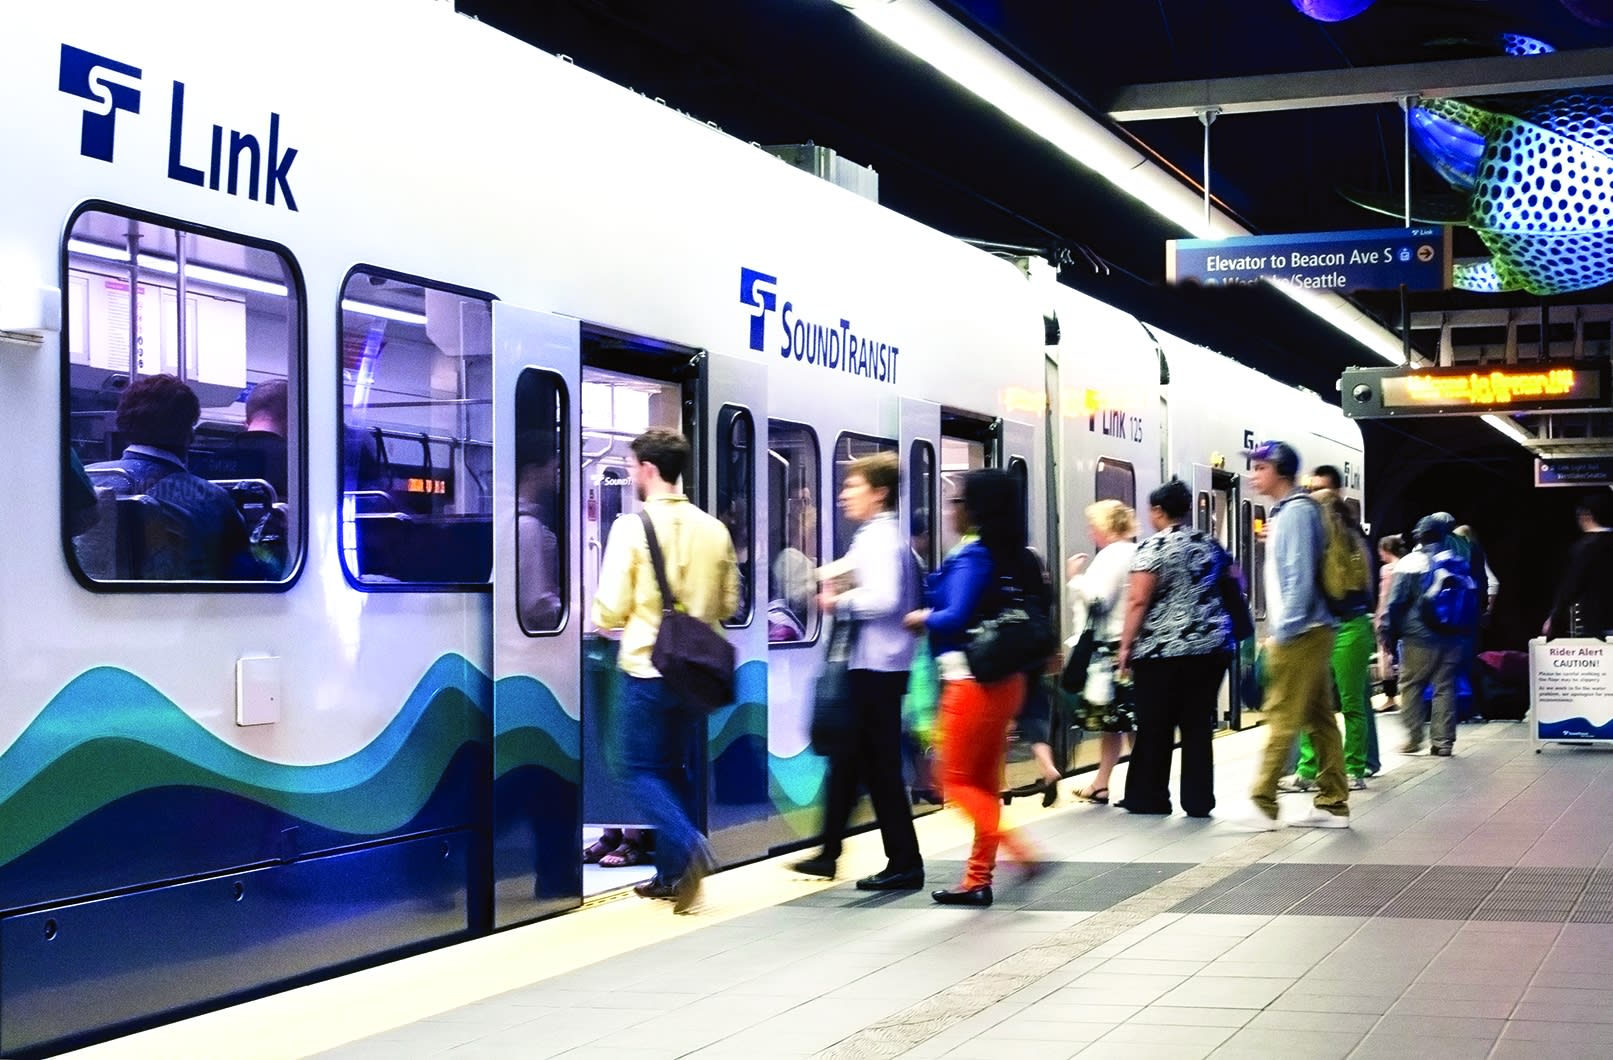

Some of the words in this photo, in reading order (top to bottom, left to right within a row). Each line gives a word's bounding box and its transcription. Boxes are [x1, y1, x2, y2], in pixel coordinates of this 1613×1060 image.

[168, 80, 299, 213] Link
[1207, 253, 1266, 272] Elevator
[1271, 254, 1286, 269] to
[1291, 249, 1344, 268] Beacon
[1349, 249, 1379, 266] Ave
[1384, 248, 1392, 263] S
[1222, 272, 1346, 290] Weske/Seattle
[1103, 408, 1126, 440] Link
[1130, 416, 1143, 444] 125
[1550, 648, 1575, 656] Rider
[1579, 648, 1603, 656] Alert
